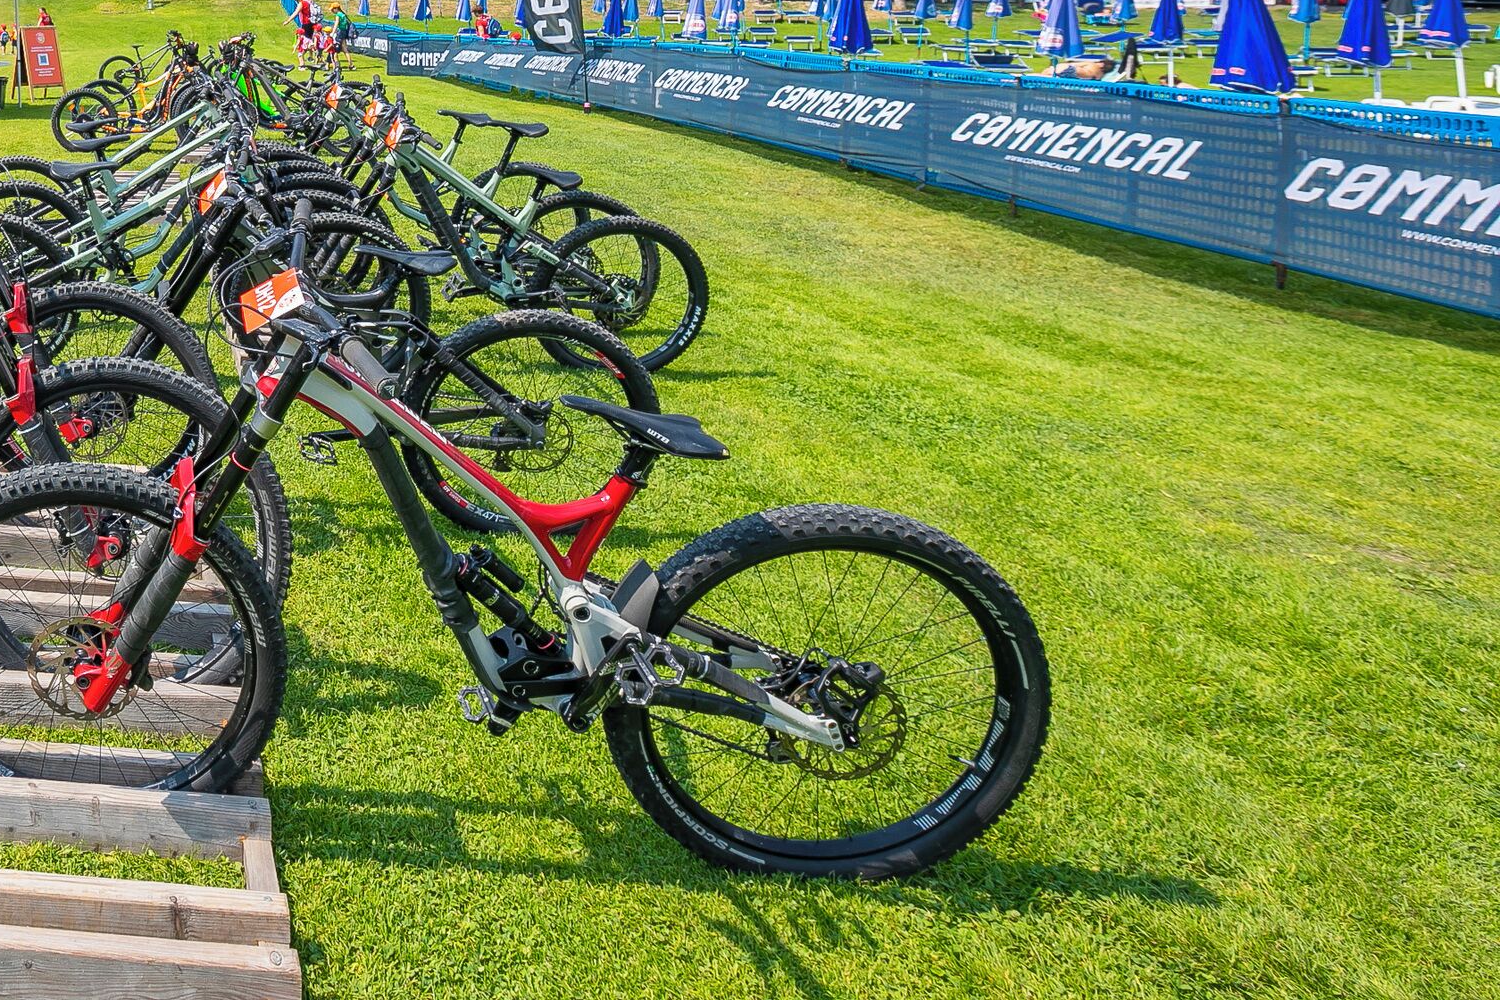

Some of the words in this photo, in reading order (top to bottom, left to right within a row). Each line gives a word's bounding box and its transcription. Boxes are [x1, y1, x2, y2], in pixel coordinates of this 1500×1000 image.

[678, 305, 702, 347] MAXXIS
[258, 488, 277, 583] SCHWAL
[952, 575, 1016, 638] PIRELLI
[655, 782, 729, 850] SCORPION
